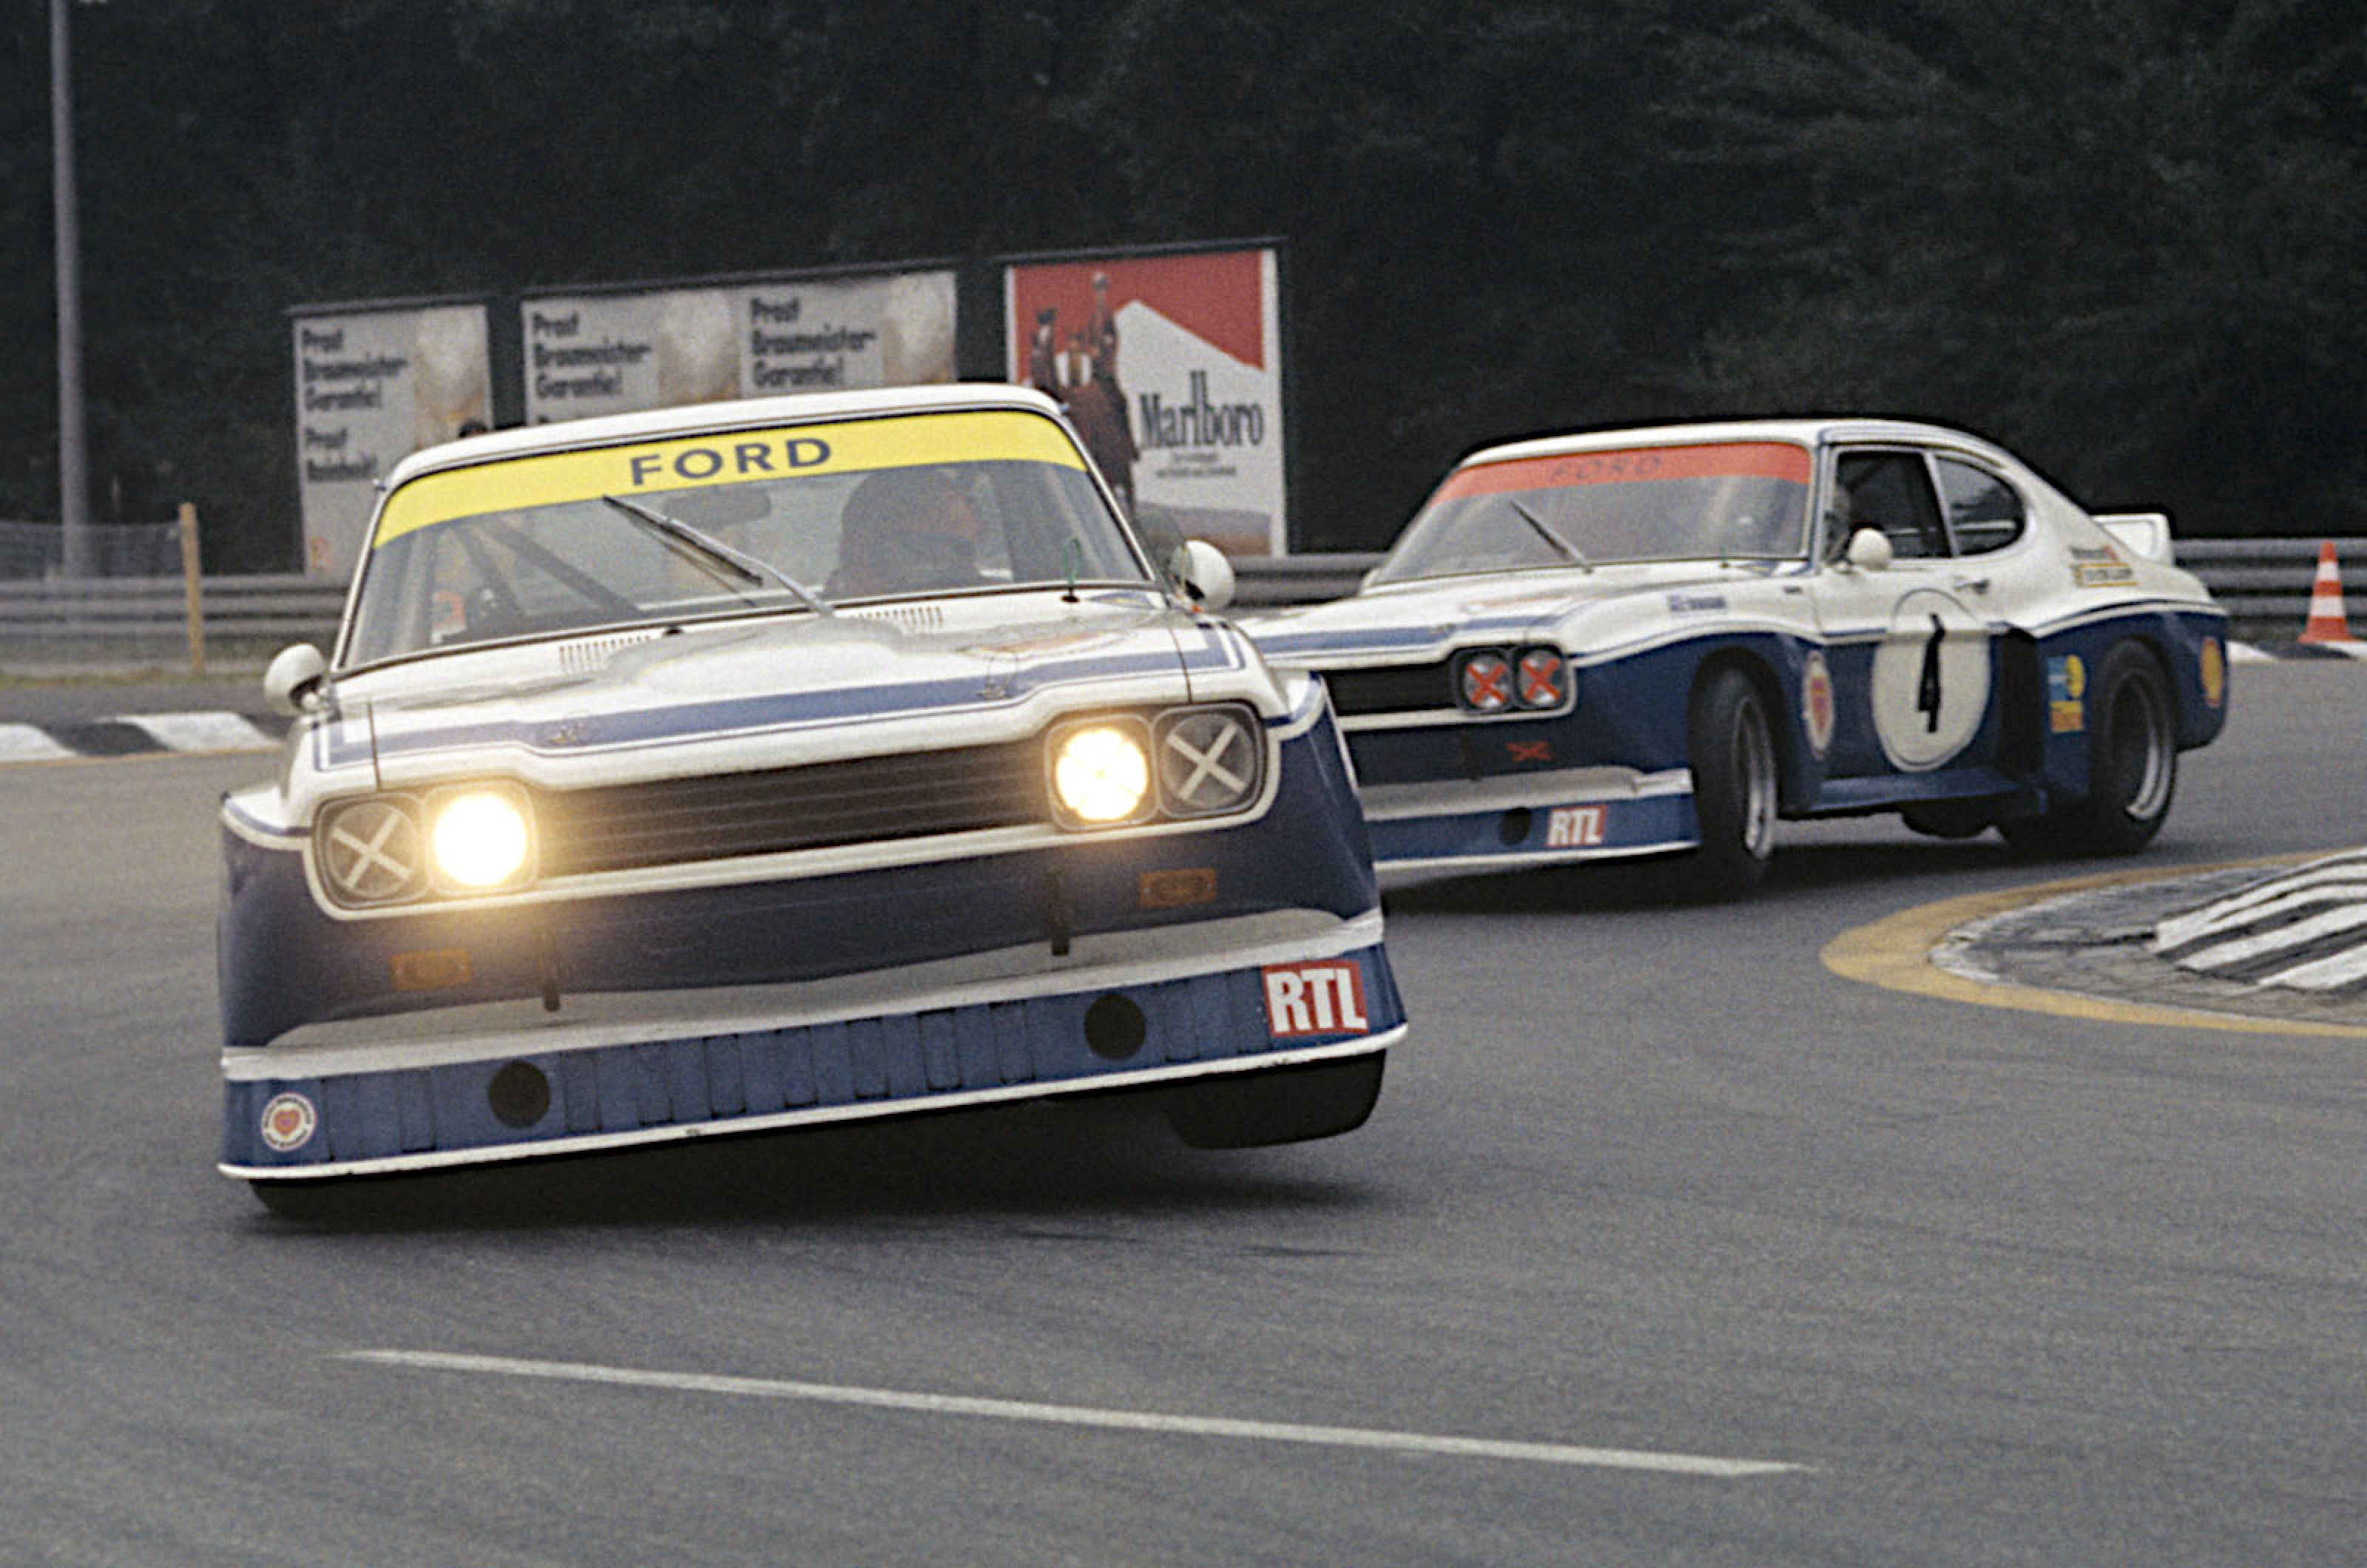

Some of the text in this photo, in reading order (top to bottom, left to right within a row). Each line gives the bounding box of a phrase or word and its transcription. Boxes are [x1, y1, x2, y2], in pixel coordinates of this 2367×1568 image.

[1138, 370, 1266, 447] Marlboro
[630, 437, 831, 486] FORD
[1550, 455, 1662, 482] FORD
[1550, 809, 1602, 845] RTL
[1266, 968, 1368, 1033] RTL
